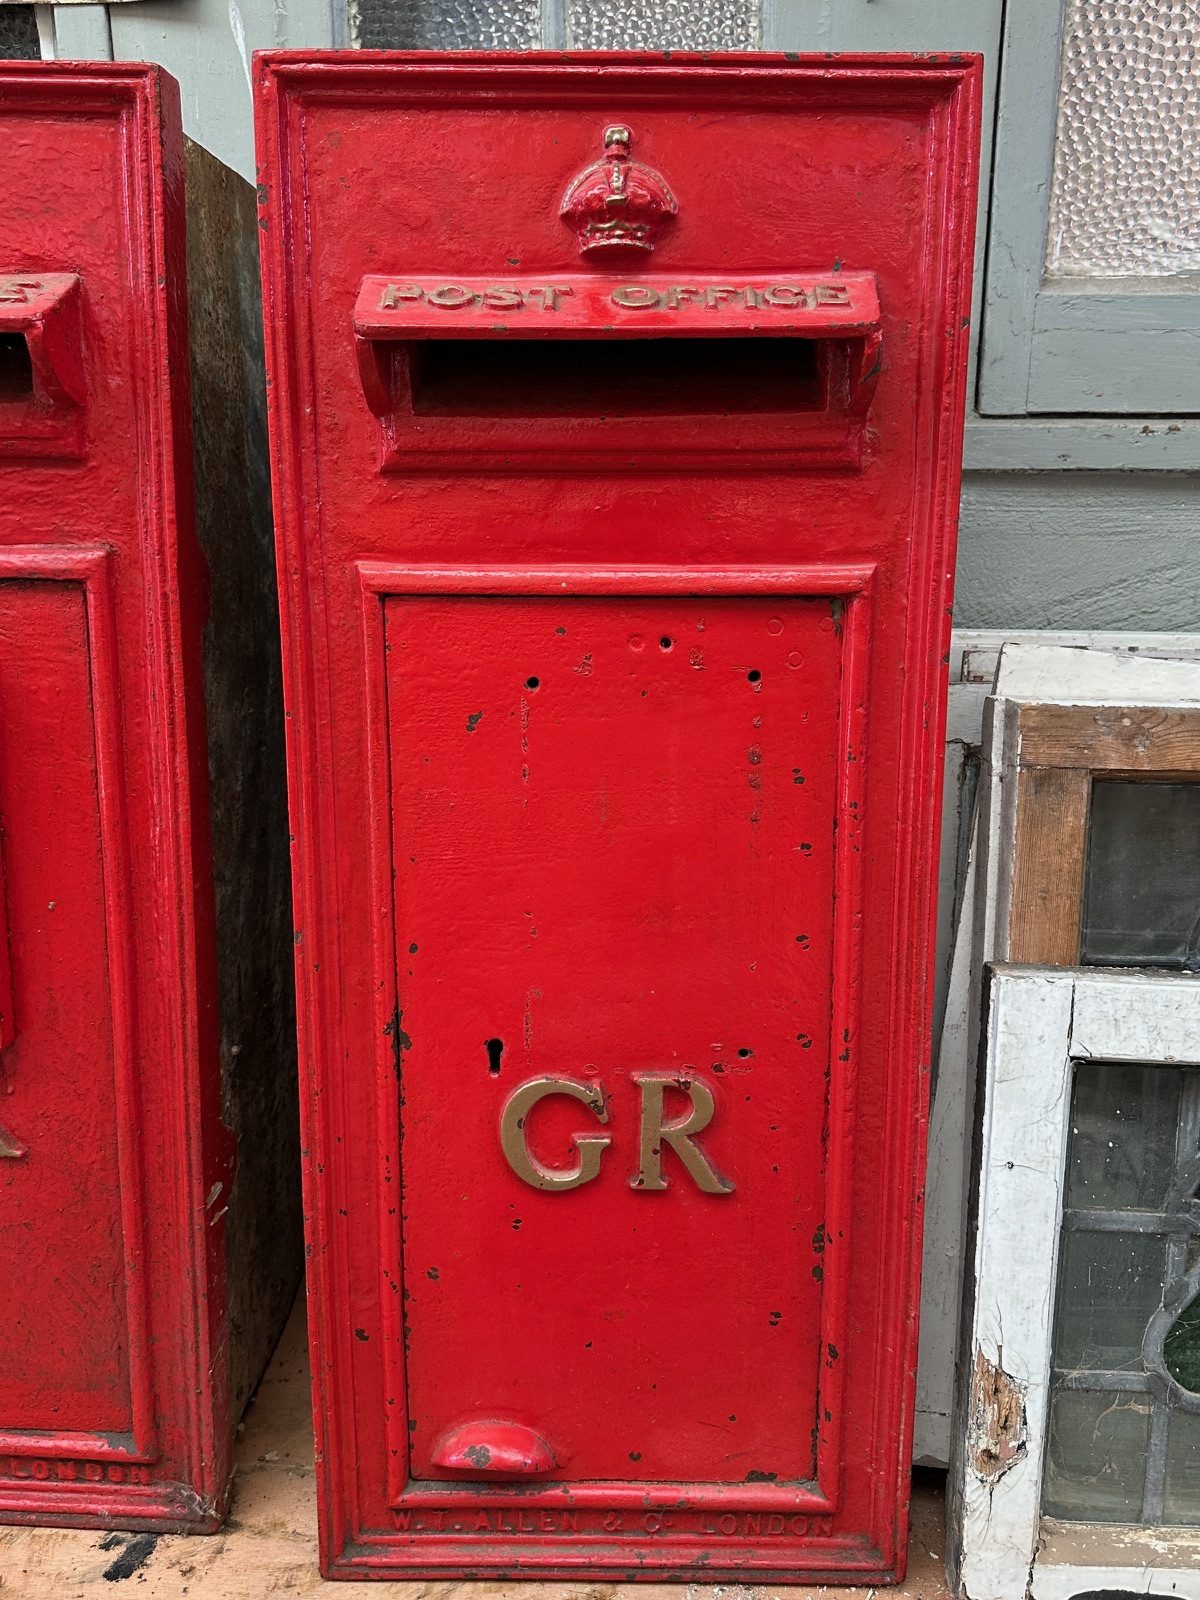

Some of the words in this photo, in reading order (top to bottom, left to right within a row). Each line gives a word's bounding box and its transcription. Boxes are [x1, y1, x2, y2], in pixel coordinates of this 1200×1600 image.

[381, 283, 576, 311] POST
[610, 283, 852, 311] OFFICE
[500, 1071, 736, 1193] GR
[10, 1457, 151, 1486] LONDON
[475, 1509, 579, 1533] ALLEN
[604, 1511, 623, 1532] &
[701, 1513, 834, 1537] LONDON
